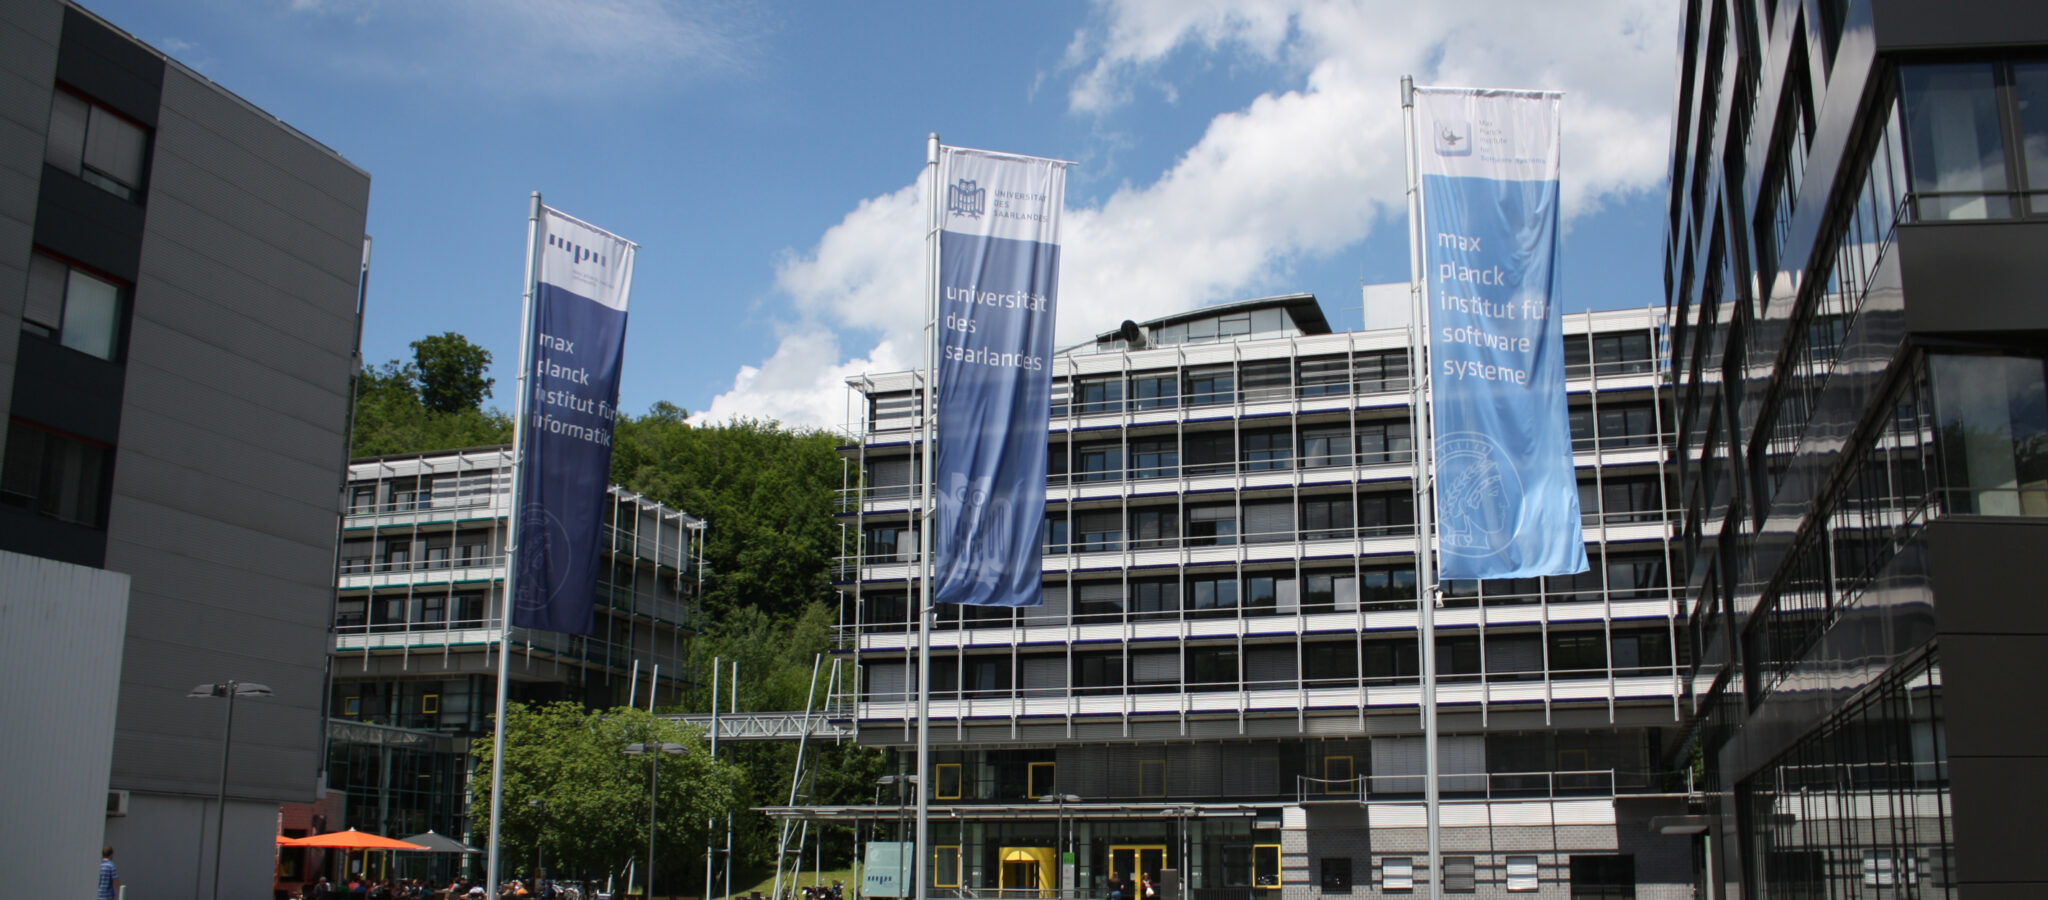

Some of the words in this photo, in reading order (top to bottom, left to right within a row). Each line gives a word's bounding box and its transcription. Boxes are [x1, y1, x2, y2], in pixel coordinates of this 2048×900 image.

[993, 199, 1010, 209] DES
[1438, 232, 1481, 252] max
[1440, 261, 1505, 287] planck
[946, 285, 1047, 313] universität
[1441, 290, 1516, 321] institut
[946, 312, 976, 334] des
[539, 332, 575, 355] max
[1442, 325, 1532, 353] software
[944, 345, 1043, 371] saarlandes
[536, 358, 590, 387] planck
[1443, 359, 1528, 385] systeme
